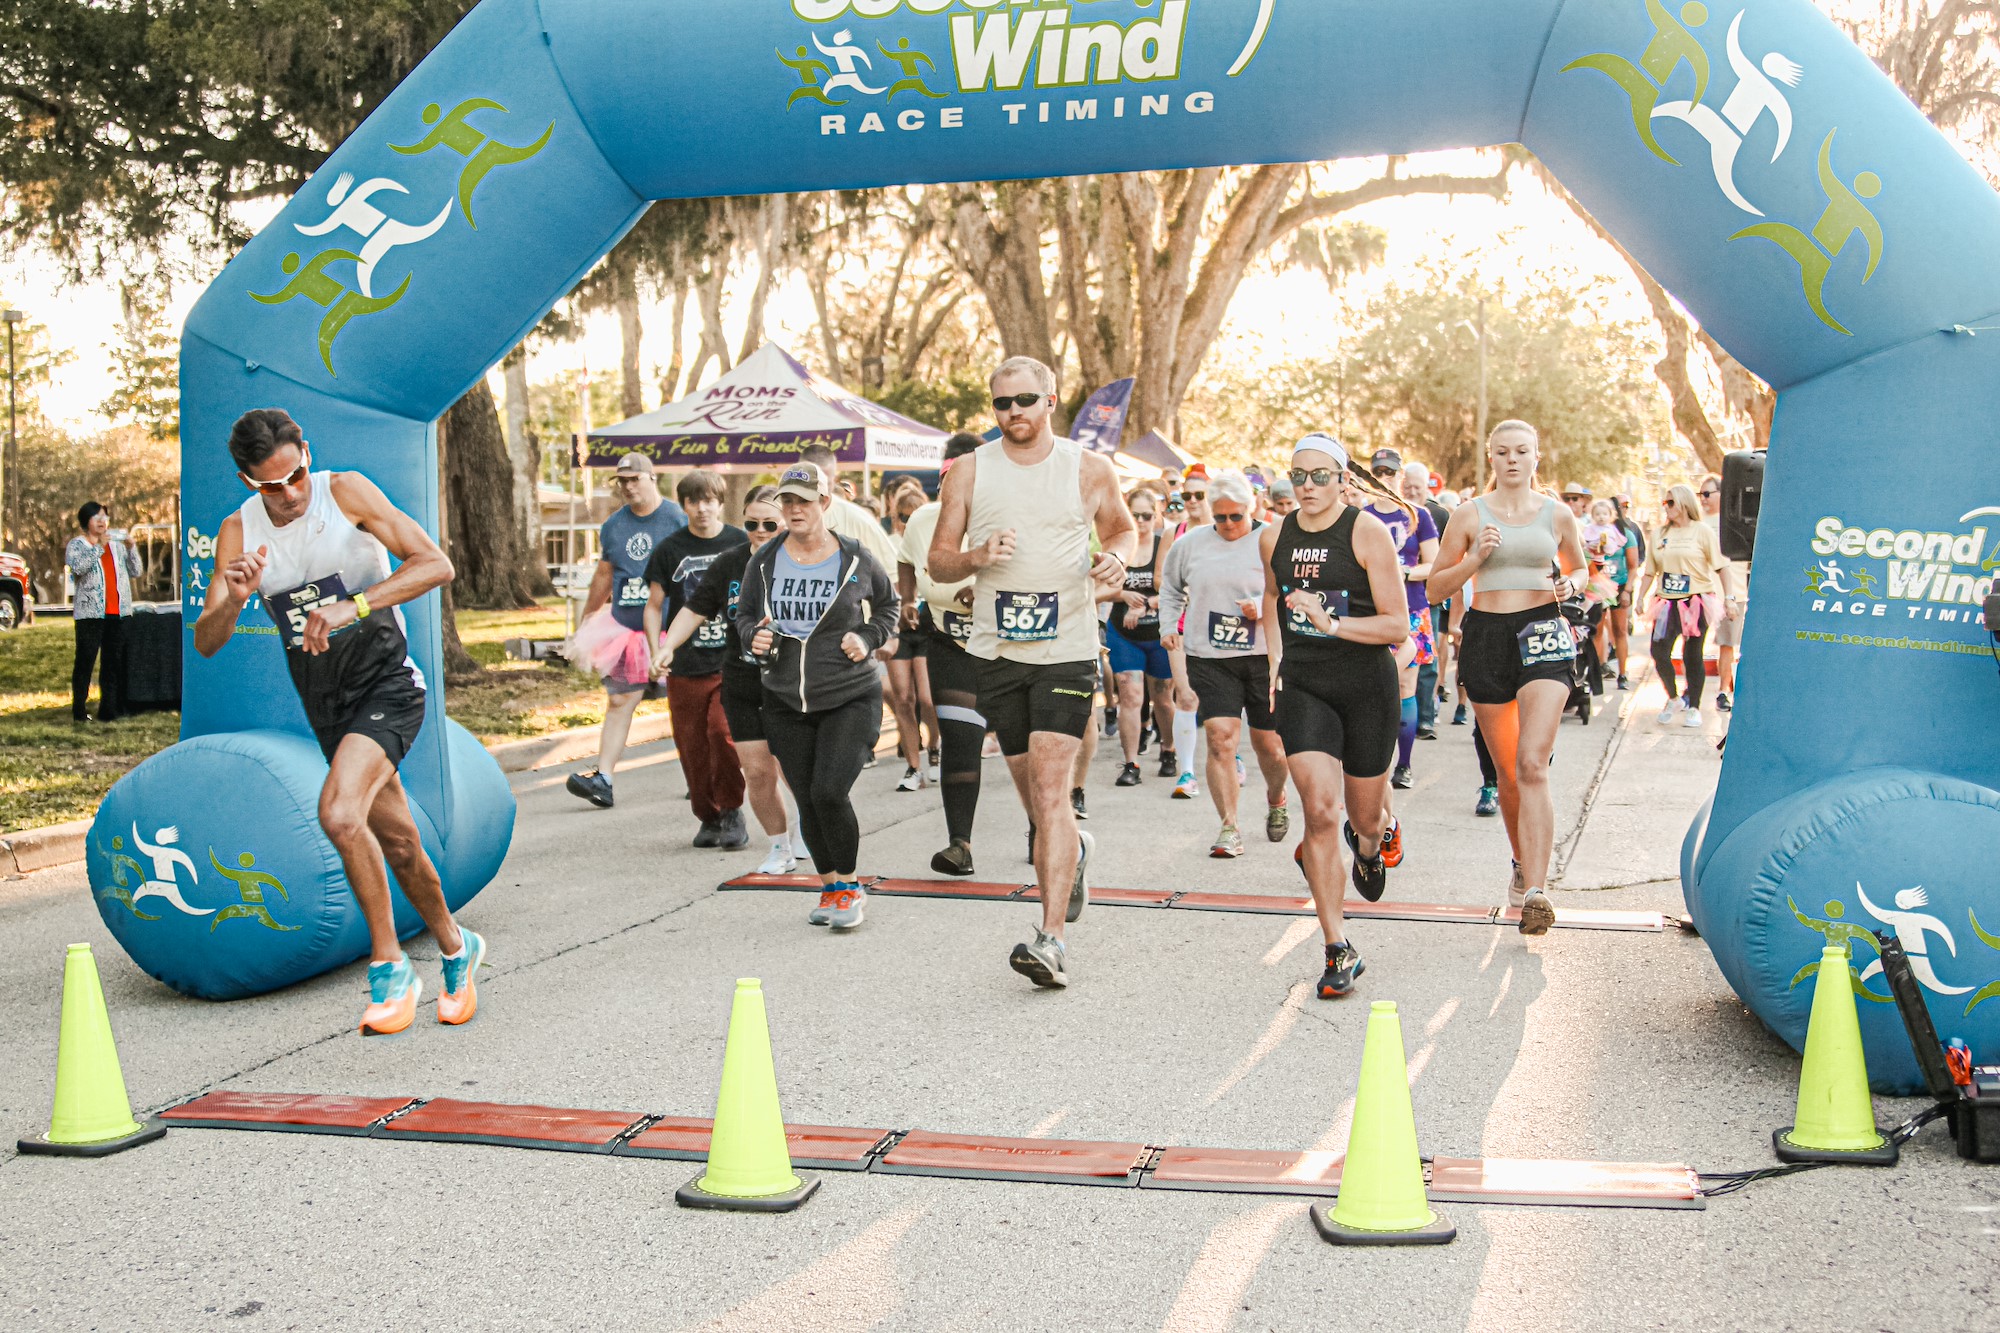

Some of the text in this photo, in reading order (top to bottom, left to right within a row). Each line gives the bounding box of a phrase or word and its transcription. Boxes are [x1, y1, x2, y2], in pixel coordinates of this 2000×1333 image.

[950, 0, 1188, 91] Wind
[820, 91, 1215, 135] RACE TIMING
[704, 385, 797, 400] MOMS
[680, 400, 780, 431] Run
[669, 436, 708, 455] Fun
[715, 436, 730, 453] &
[1811, 517, 1986, 564] Second
[1292, 549, 1328, 562] MORE
[1294, 565, 1320, 578] LIFE
[622, 585, 650, 599] 536
[781, 578, 834, 597] HATE
[1665, 580, 1686, 591] 527
[1002, 607, 1051, 630] 567
[1811, 600, 1986, 625] RACE TIMIN
[950, 624, 973, 637] 58
[1213, 624, 1249, 643] 572
[1527, 631, 1571, 655] 568
